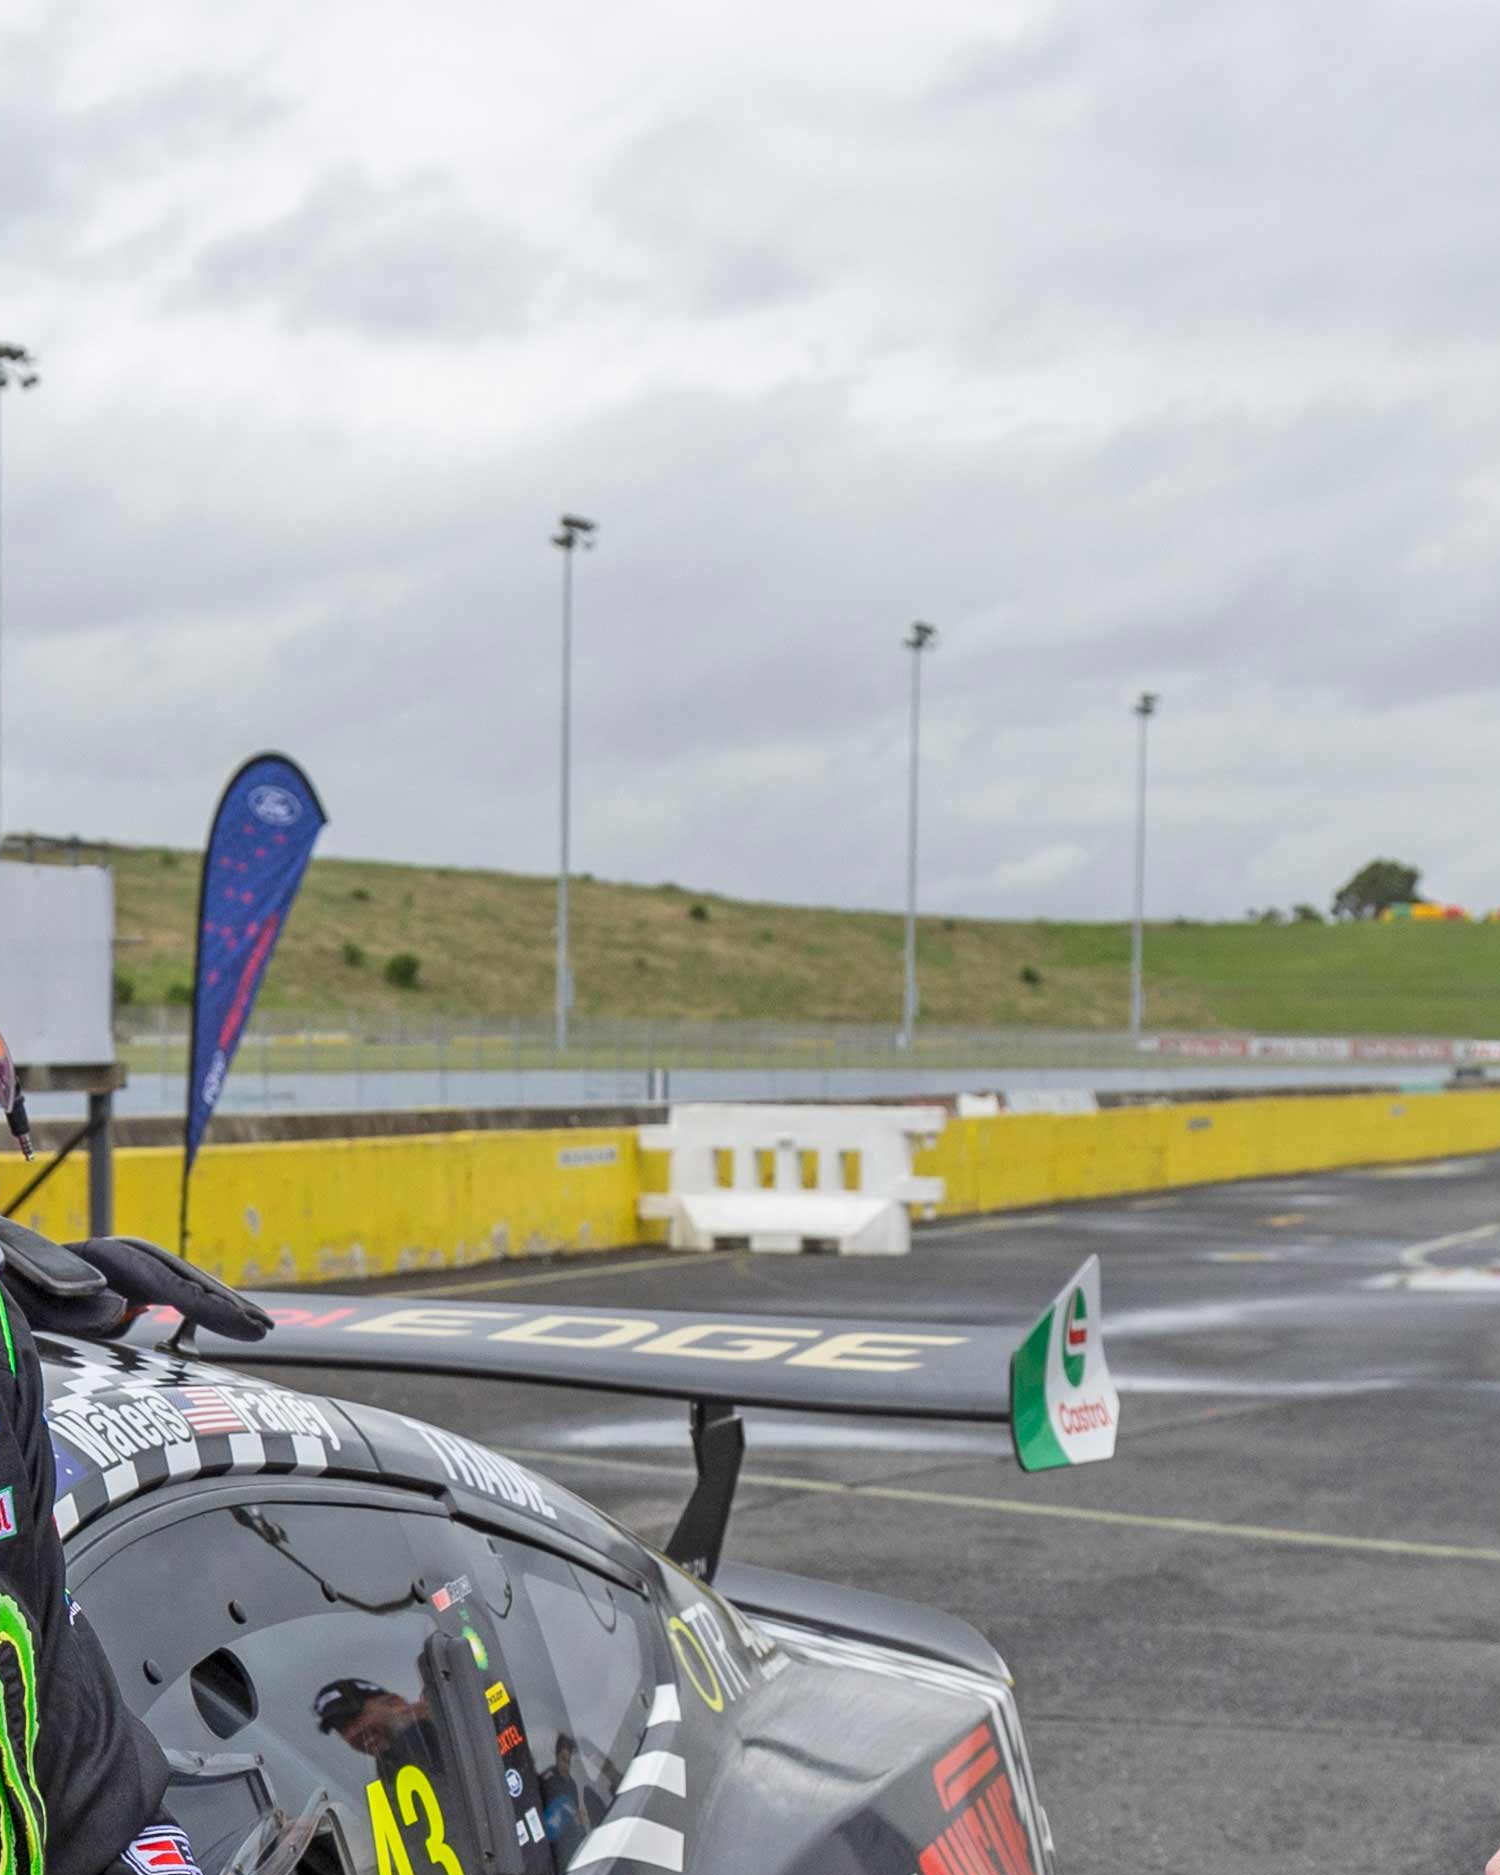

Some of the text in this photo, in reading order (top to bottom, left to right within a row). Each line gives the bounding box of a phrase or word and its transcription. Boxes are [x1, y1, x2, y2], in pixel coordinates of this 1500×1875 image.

[343, 1306, 971, 1372] EDGE
[47, 1388, 193, 1470] Waters
[1058, 1397, 1113, 1437] Castrol
